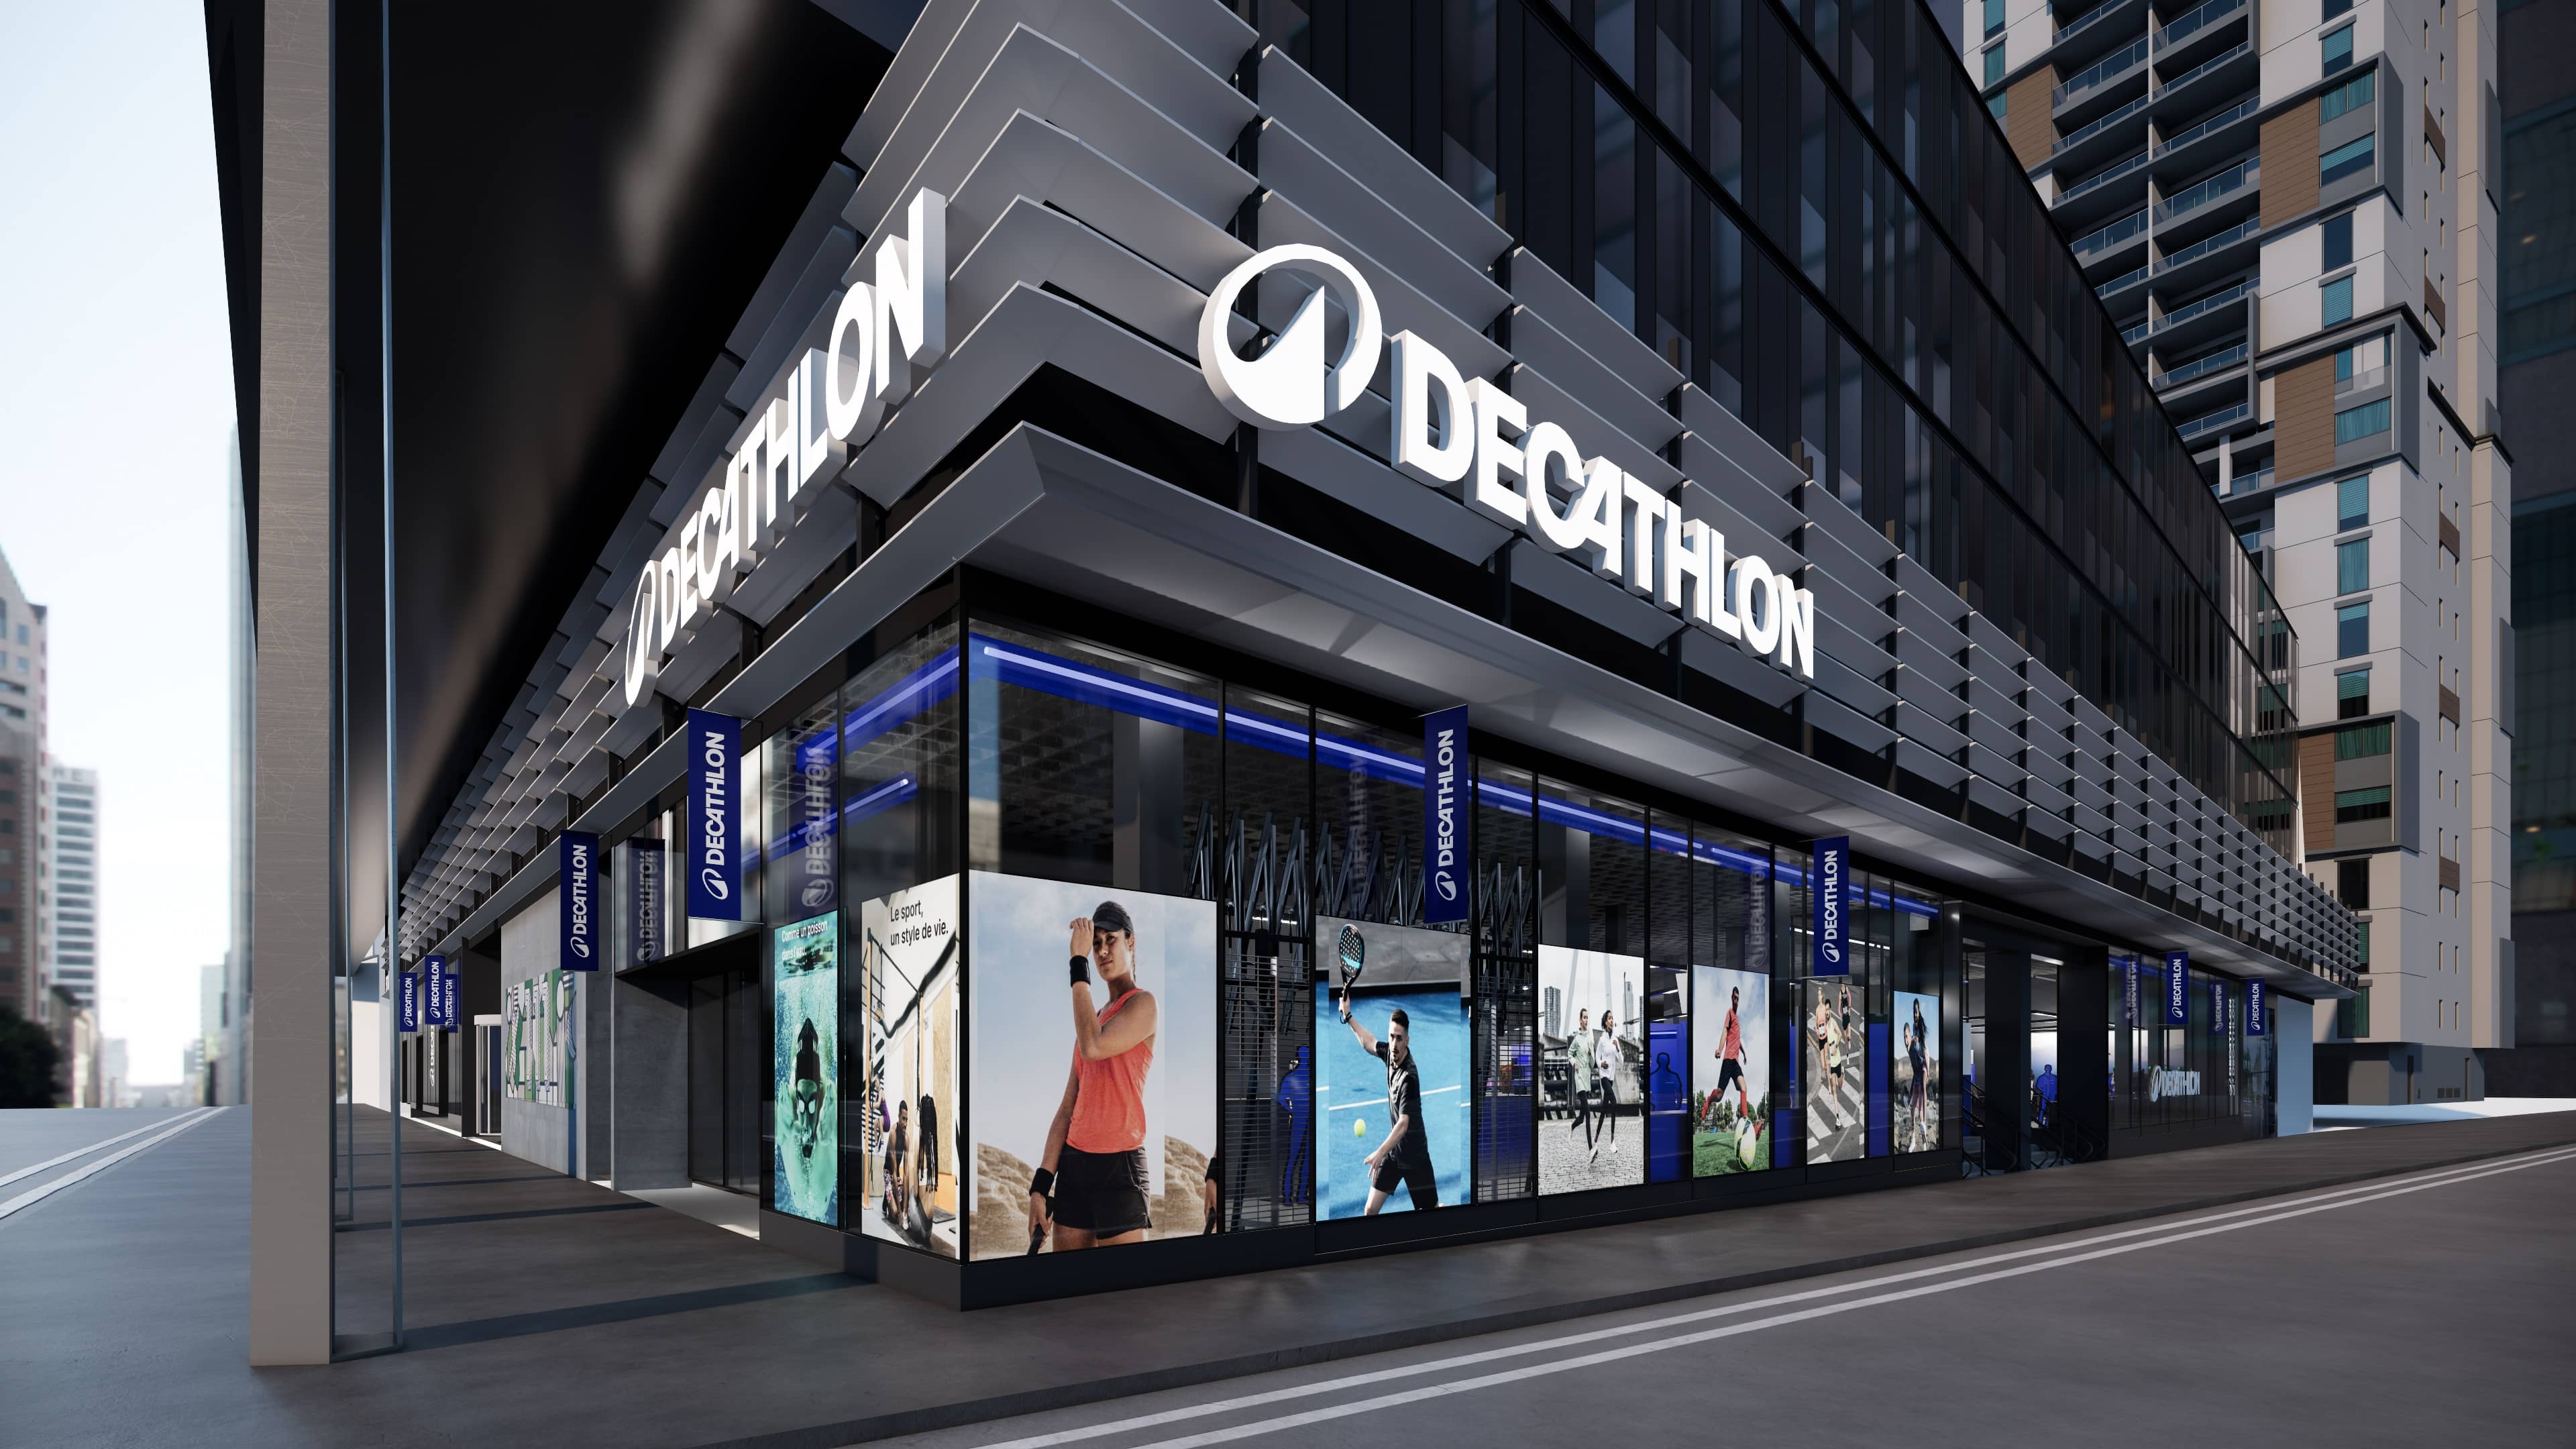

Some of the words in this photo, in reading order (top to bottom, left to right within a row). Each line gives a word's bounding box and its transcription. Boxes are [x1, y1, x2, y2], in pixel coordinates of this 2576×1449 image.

[660, 186, 945, 653] DECATHLON
[1391, 329, 1814, 680] DECATHLON
[706, 731, 724, 865] DECATHLON
[1438, 729, 1454, 867] DECATHLON
[573, 844, 587, 934] DECATHLON
[890, 906, 899, 922] Le
[901, 900, 923, 920] sport,
[1824, 850, 1837, 940] DECATHLON
[782, 926, 799, 943] Comme
[800, 925, 807, 937] un
[807, 920, 828, 937] poisson
[782, 947, 793, 961] dans
[890, 932, 900, 946] un
[902, 926, 920, 947] style
[922, 923, 932, 939] de
[933, 919, 949, 938] vie.
[431, 961, 439, 1007] DECATHLON
[2174, 959, 2182, 1006] DECATHLON
[2161, 1071, 2200, 1096] DECATHLON
